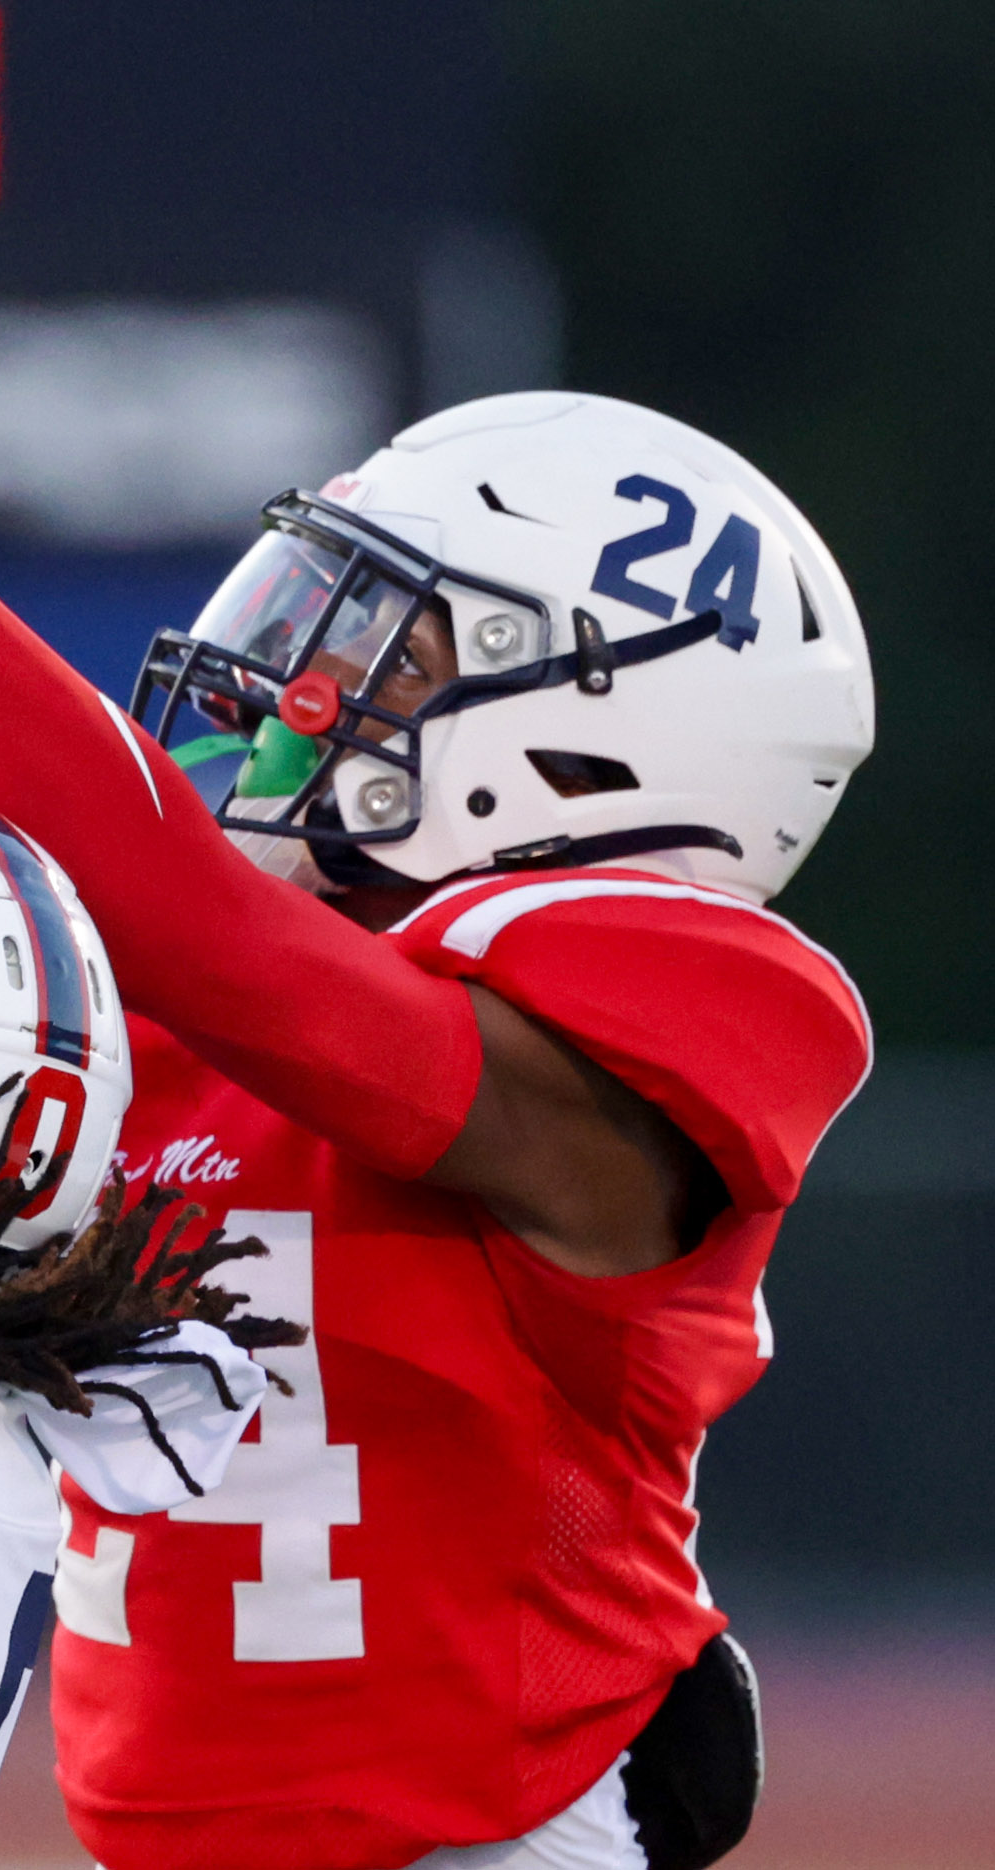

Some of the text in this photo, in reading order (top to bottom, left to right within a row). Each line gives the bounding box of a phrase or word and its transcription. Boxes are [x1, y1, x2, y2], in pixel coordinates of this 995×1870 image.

[590, 473, 760, 653] 24
[153, 1134, 241, 1184] Mtn
[53, 1210, 365, 1662] 4
